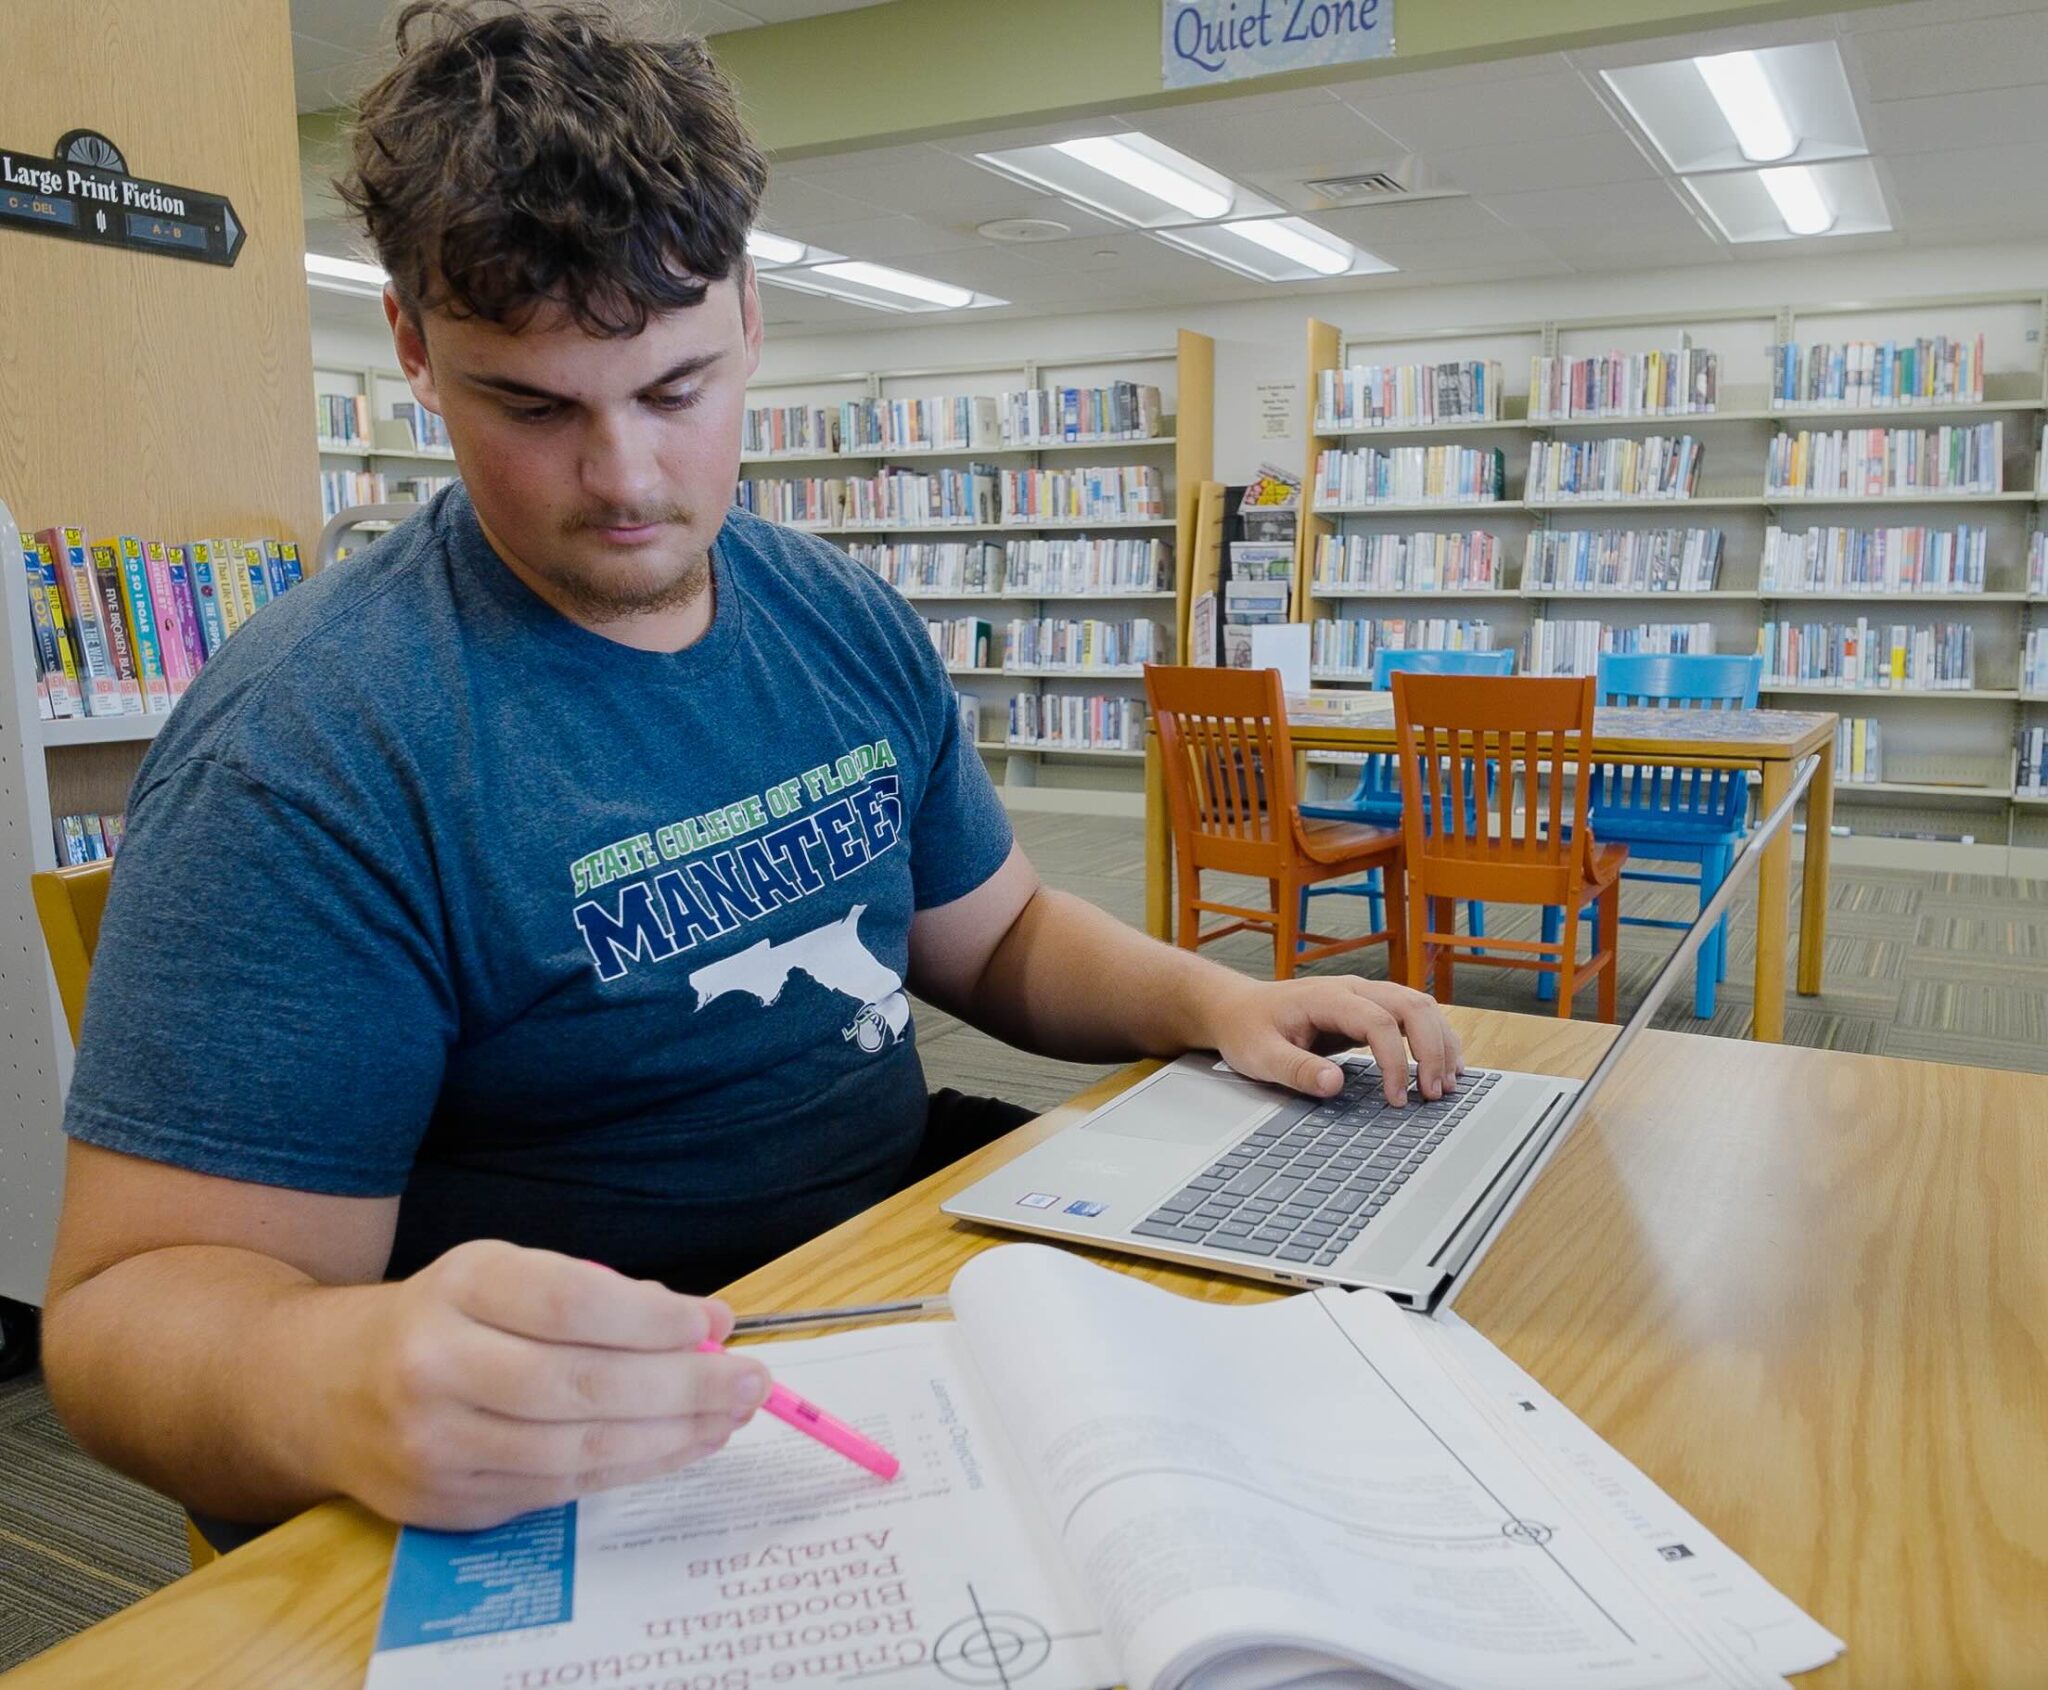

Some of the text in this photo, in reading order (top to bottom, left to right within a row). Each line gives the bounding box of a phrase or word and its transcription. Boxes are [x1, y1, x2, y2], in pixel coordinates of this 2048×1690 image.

[1174, 0, 1379, 72] Quiet Zone
[3, 156, 186, 217] Large Print Fiction
[33, 203, 56, 216] DEL
[152, 224, 161, 235] A
[173, 228, 182, 238] B
[131, 575, 142, 591] SO
[217, 562, 228, 579] That
[221, 583, 232, 599] Life
[236, 563, 246, 581] That
[32, 587, 48, 627] BOX
[76, 577, 95, 621] CONNELLY
[105, 588, 119, 612] FIVE
[205, 602, 216, 617] THE
[240, 584, 250, 600] Life
[111, 612, 127, 655] BROKEN
[136, 601, 149, 632] ROAR
[85, 627, 105, 675] THE WAITI
[571, 831, 660, 899] STATE
[765, 777, 802, 818] OF
[801, 739, 897, 802] FLODA
[687, 1529, 892, 1579] Analysis
[720, 1556, 901, 1600] Pattern
[646, 1581, 909, 1640] Bloodstain
[505, 1609, 920, 1687] Reconstruction:
[627, 1638, 927, 1690] Crime-Sce
